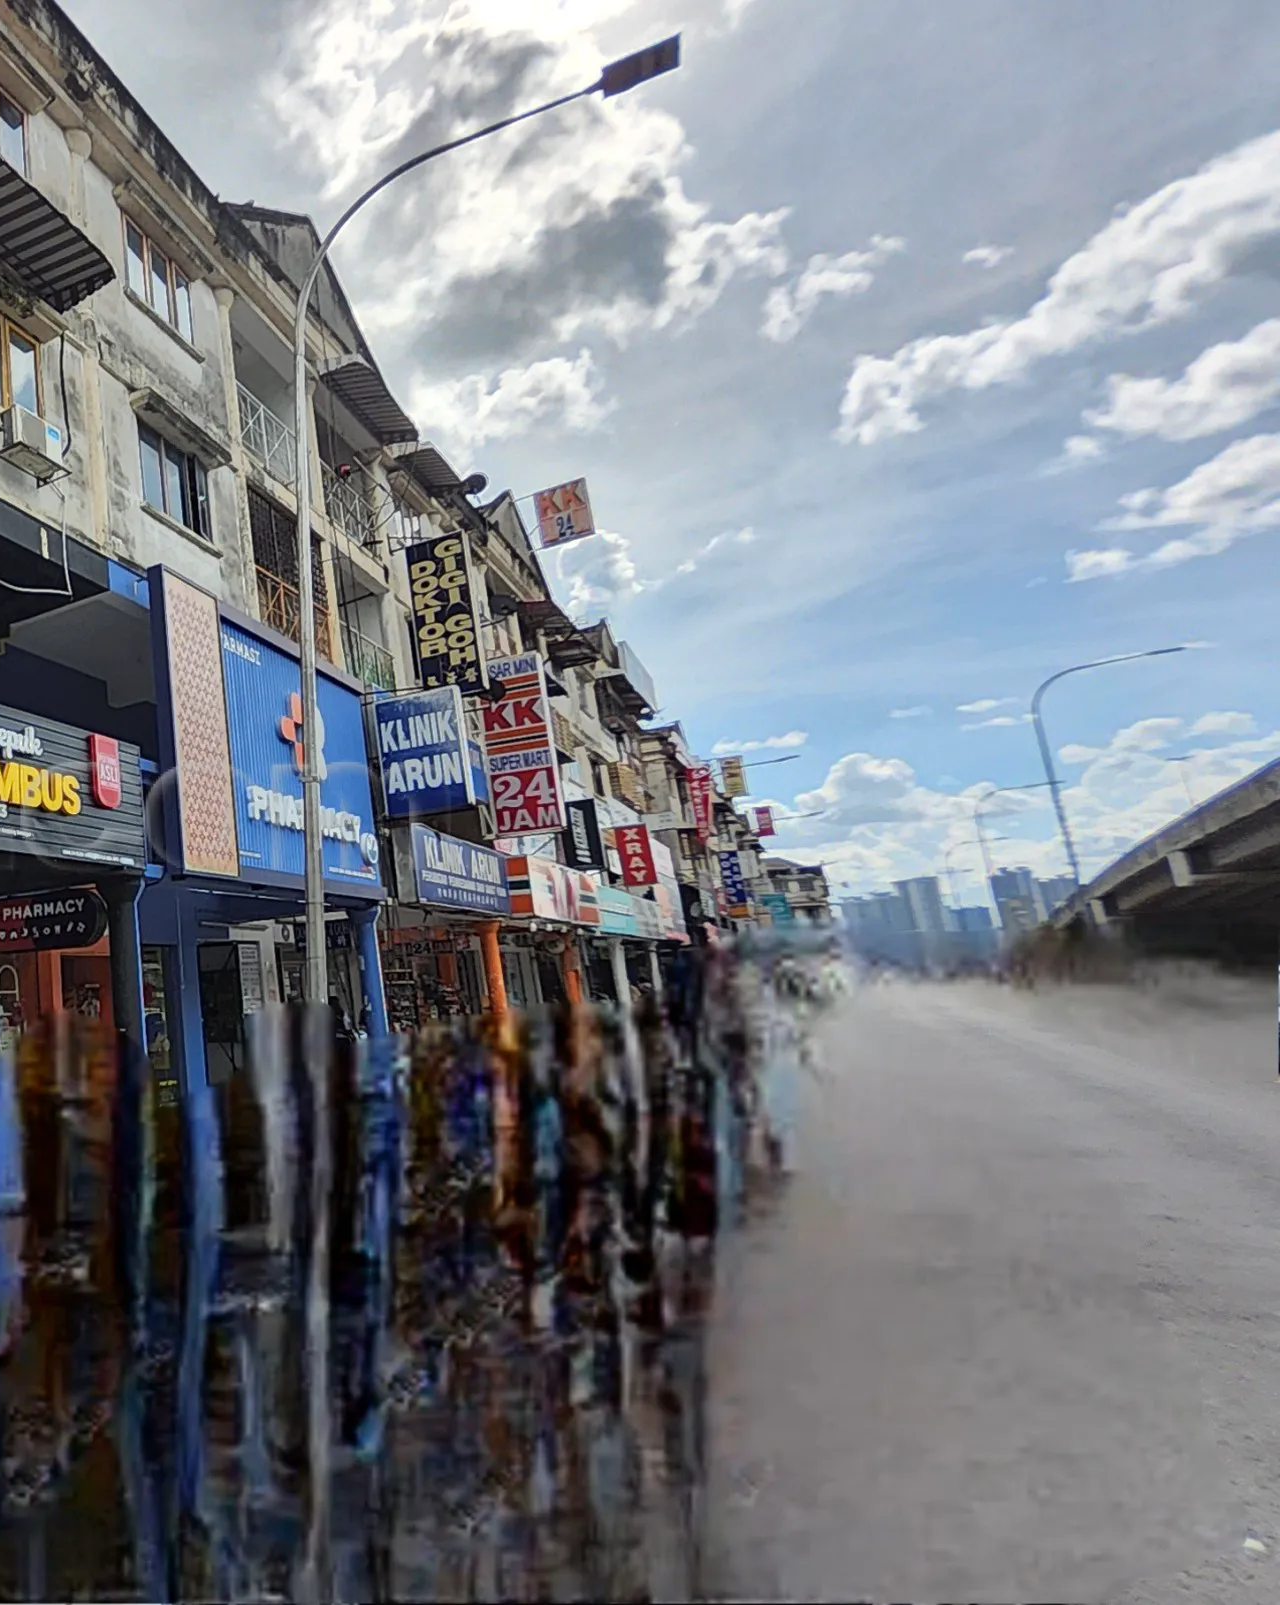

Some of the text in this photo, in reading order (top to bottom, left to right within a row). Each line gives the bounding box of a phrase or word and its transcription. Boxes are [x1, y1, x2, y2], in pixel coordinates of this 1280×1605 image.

[537, 482, 586, 520] KK
[556, 513, 575, 537] 24
[434, 538, 467, 605] GIGI
[410, 560, 449, 659] DOKTOR
[445, 613, 475, 666] GOH
[488, 662, 513, 679] SAR
[380, 709, 457, 752] KLINIK
[483, 697, 545, 732] KK
[100, 763, 118, 782] ASLI
[388, 751, 463, 794] ARUN
[490, 749, 552, 772] SUPER MART
[494, 770, 555, 809] 24
[499, 807, 560, 831] JAM
[424, 835, 466, 876] KLINIK
[471, 849, 501, 885] ARUN
[2, 898, 84, 922] PHARMACY
